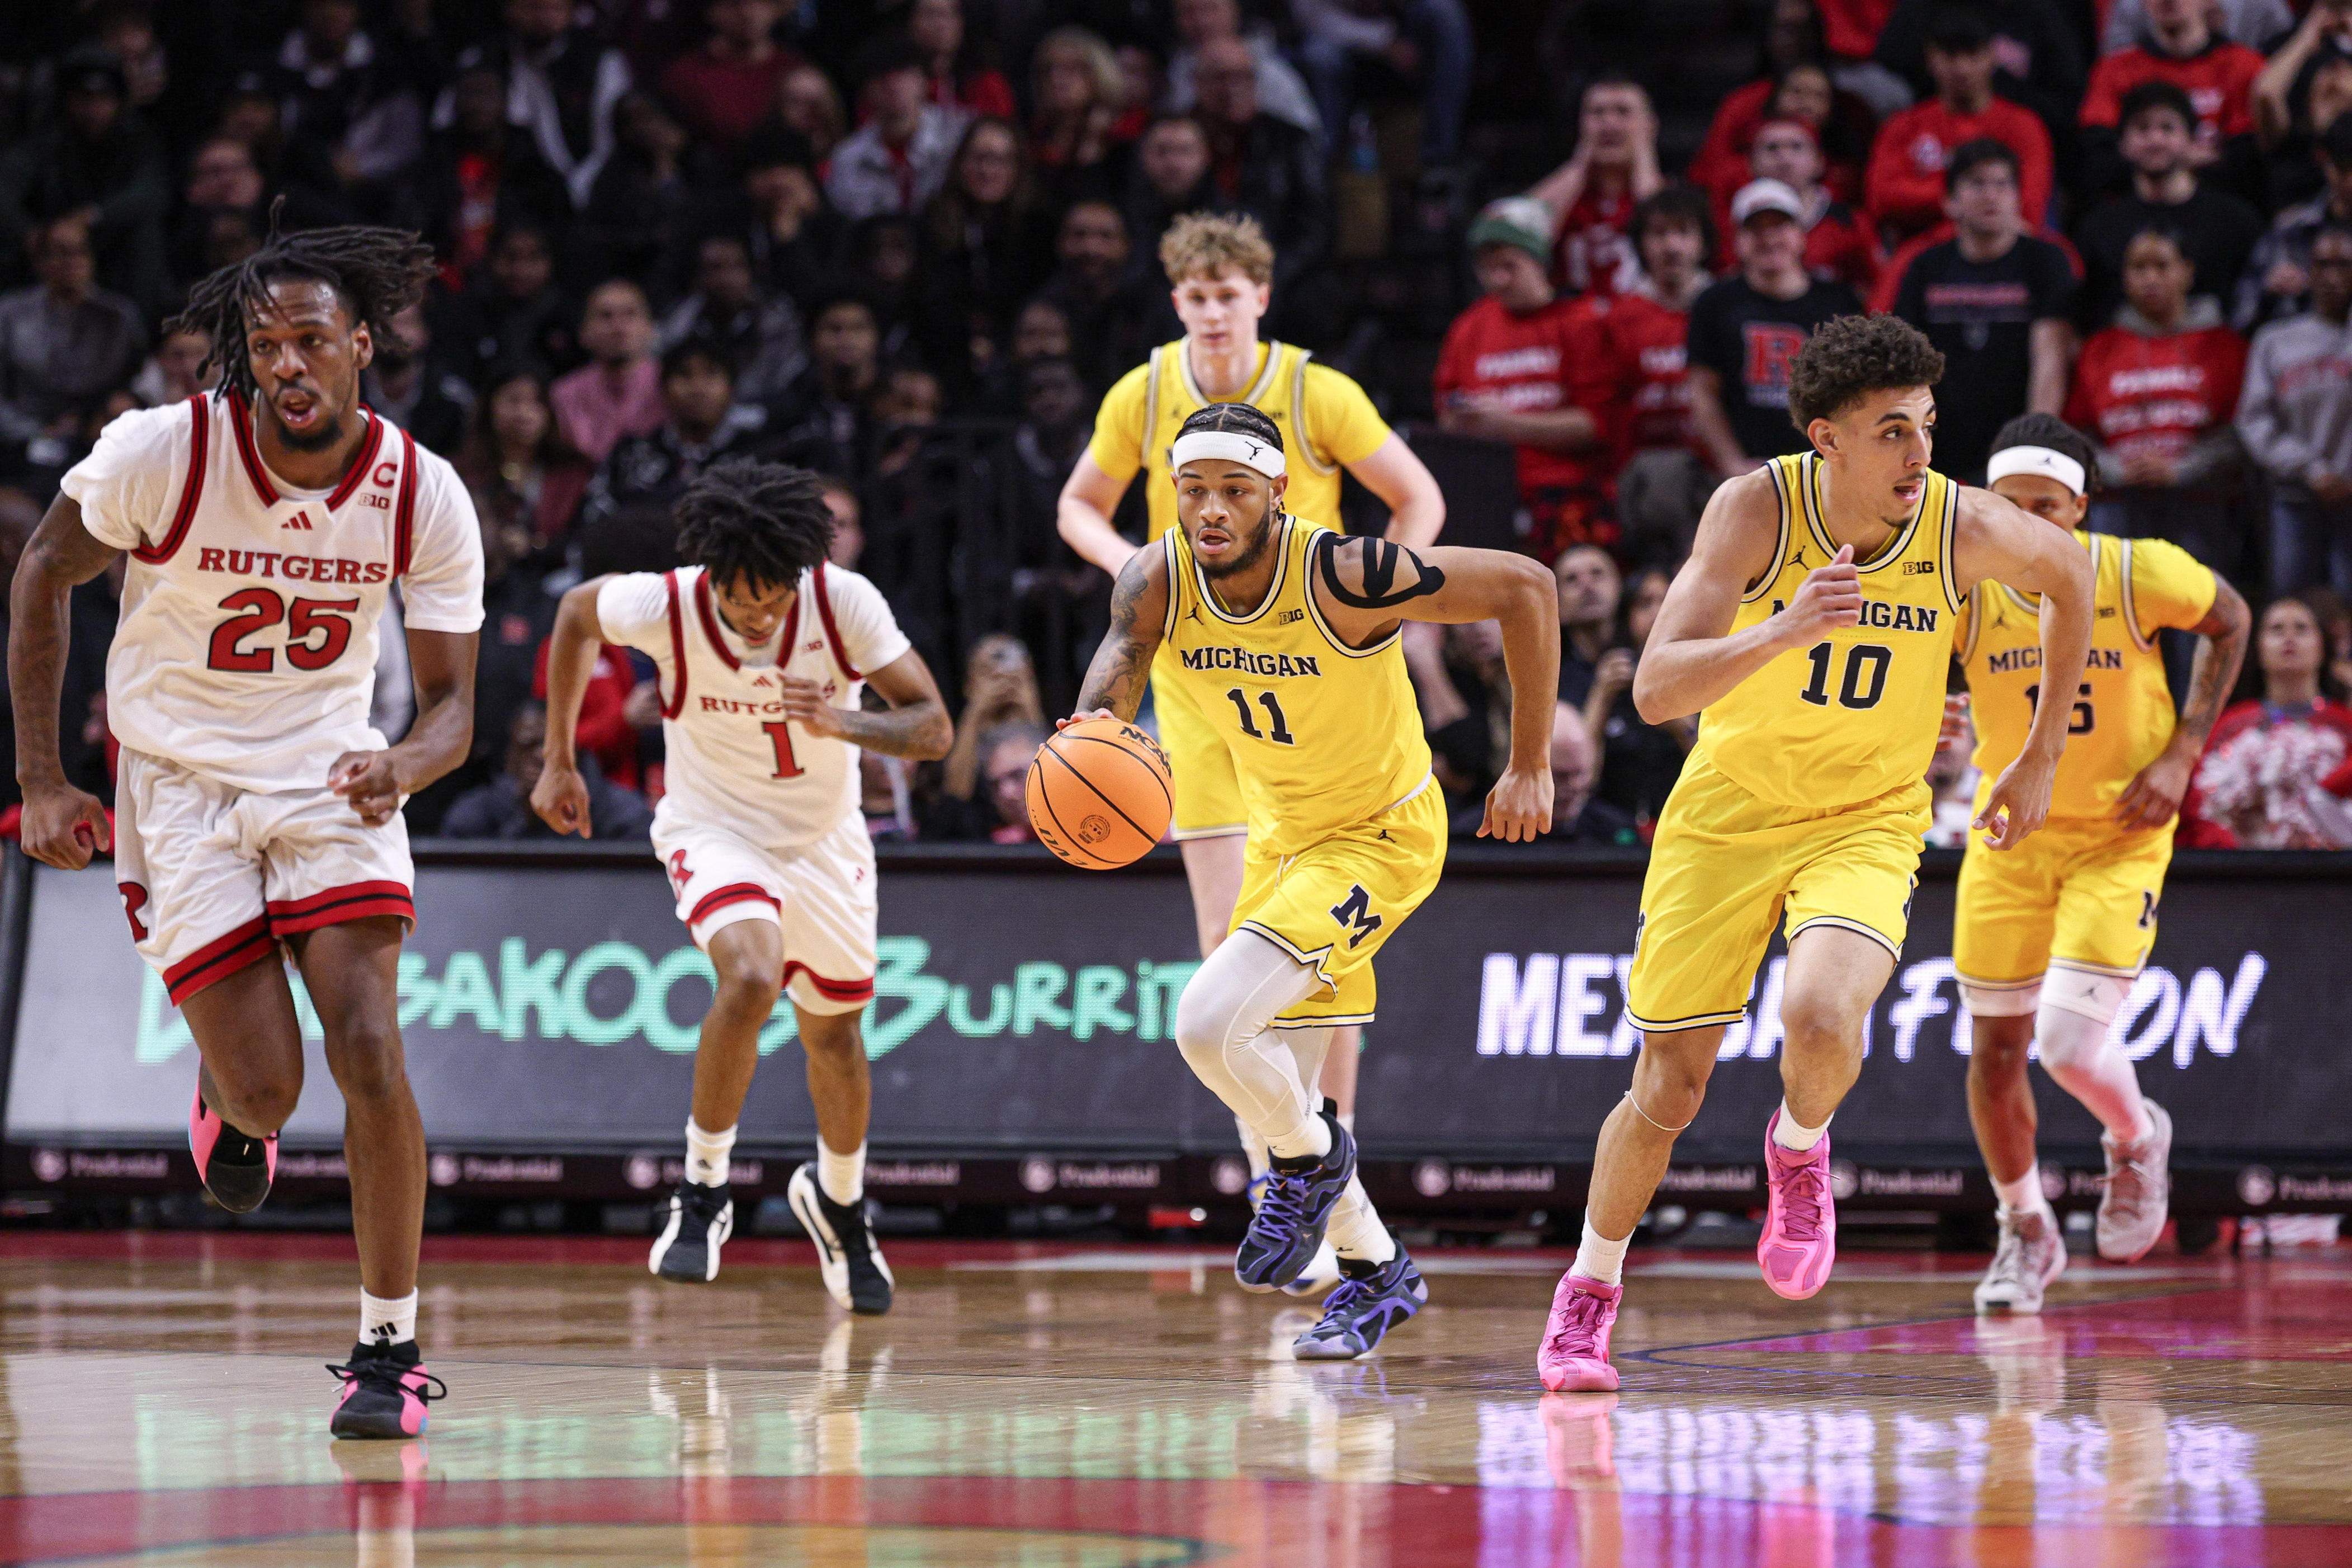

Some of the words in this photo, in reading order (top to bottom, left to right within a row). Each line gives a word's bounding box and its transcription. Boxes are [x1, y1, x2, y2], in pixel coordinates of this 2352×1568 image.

[372, 462, 398, 488] C
[197, 547, 388, 584] RUTGERS
[207, 587, 360, 673] 25
[1180, 646, 1323, 677] MICHIGAN
[1800, 641, 1894, 710] 10
[1226, 686, 1296, 746] 11
[761, 720, 805, 781] 1
[1328, 882, 1383, 951] M
